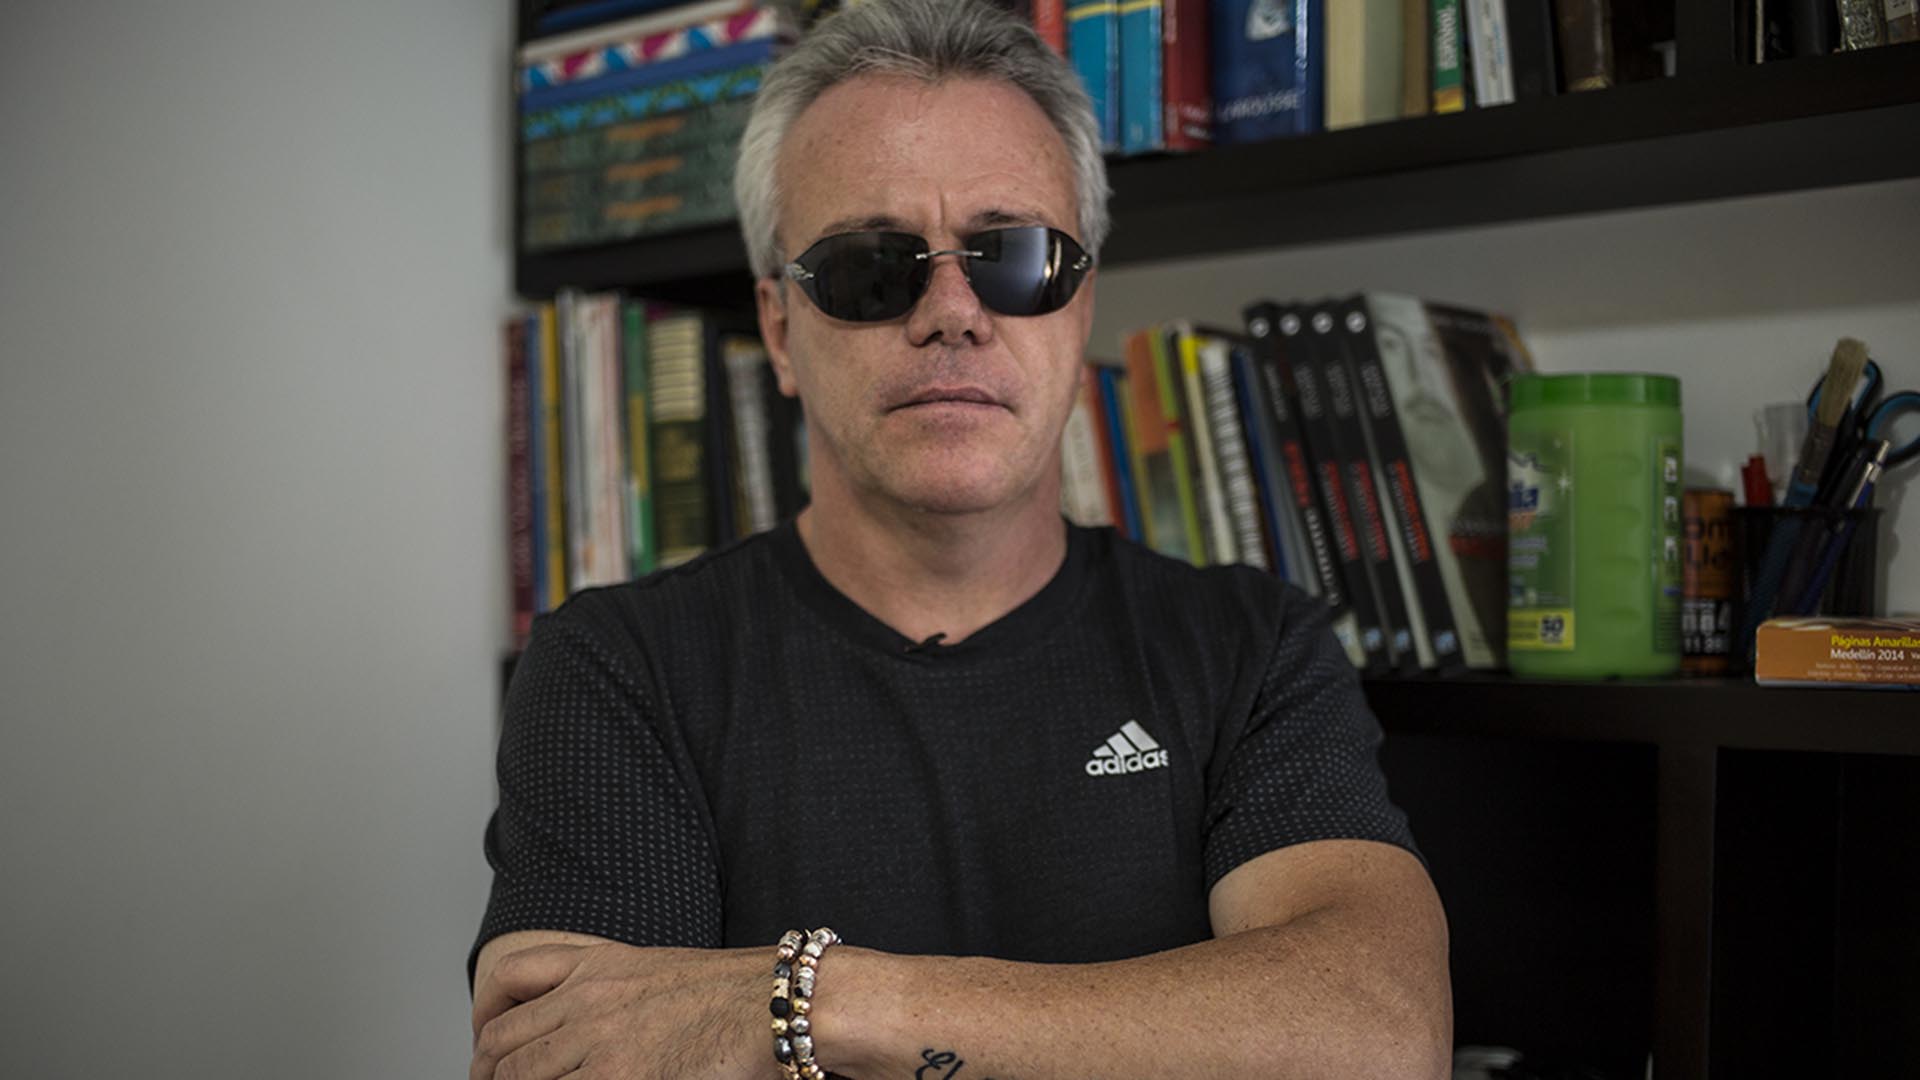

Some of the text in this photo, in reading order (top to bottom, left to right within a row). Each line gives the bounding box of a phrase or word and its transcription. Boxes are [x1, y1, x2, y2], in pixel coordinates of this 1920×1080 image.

[1831, 635, 1871, 648] Páginas
[1830, 648, 1876, 660] Medellín
[1878, 649, 1904, 660] 2014
[1085, 749, 1169, 776] adidas
